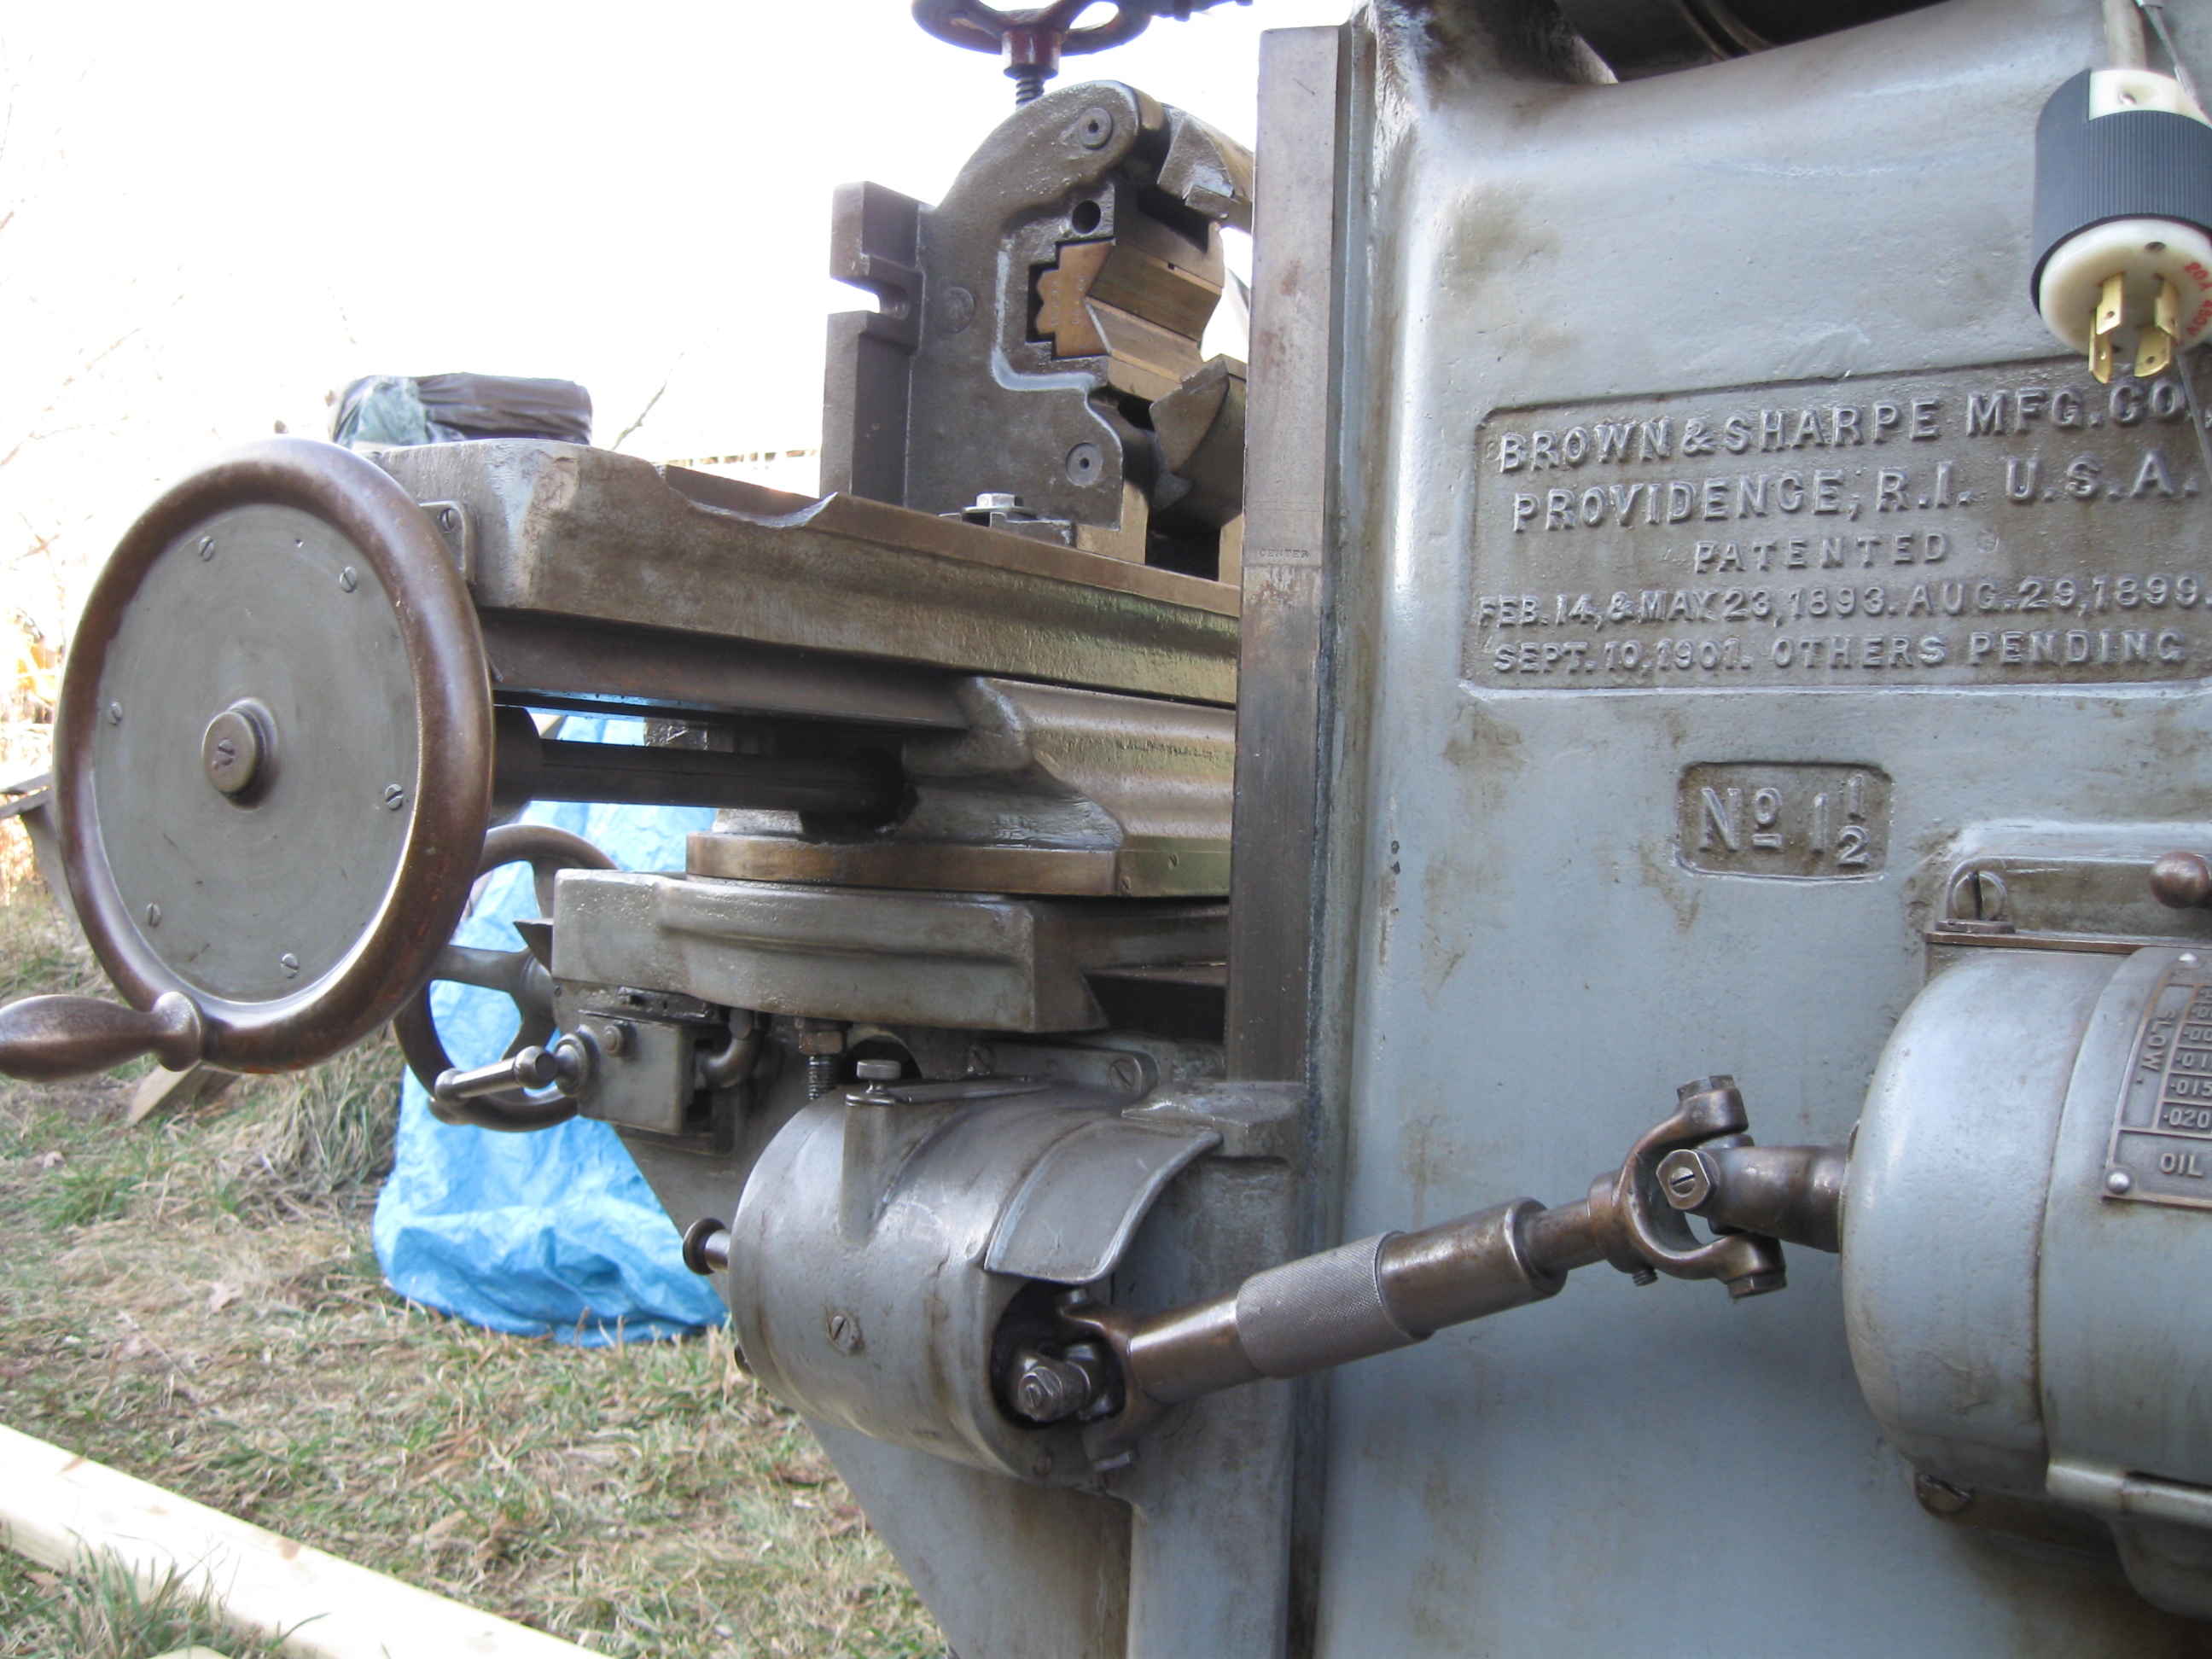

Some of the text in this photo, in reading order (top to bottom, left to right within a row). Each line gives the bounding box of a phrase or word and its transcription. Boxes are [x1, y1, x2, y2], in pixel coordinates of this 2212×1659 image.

[1259, 548, 1310, 559] CENTER
[1695, 531, 1949, 574] PATENTED
[1770, 635, 1948, 669] OTHERS
[1968, 628, 2188, 667] PENDING
[2159, 1152, 2203, 1179] OIL
